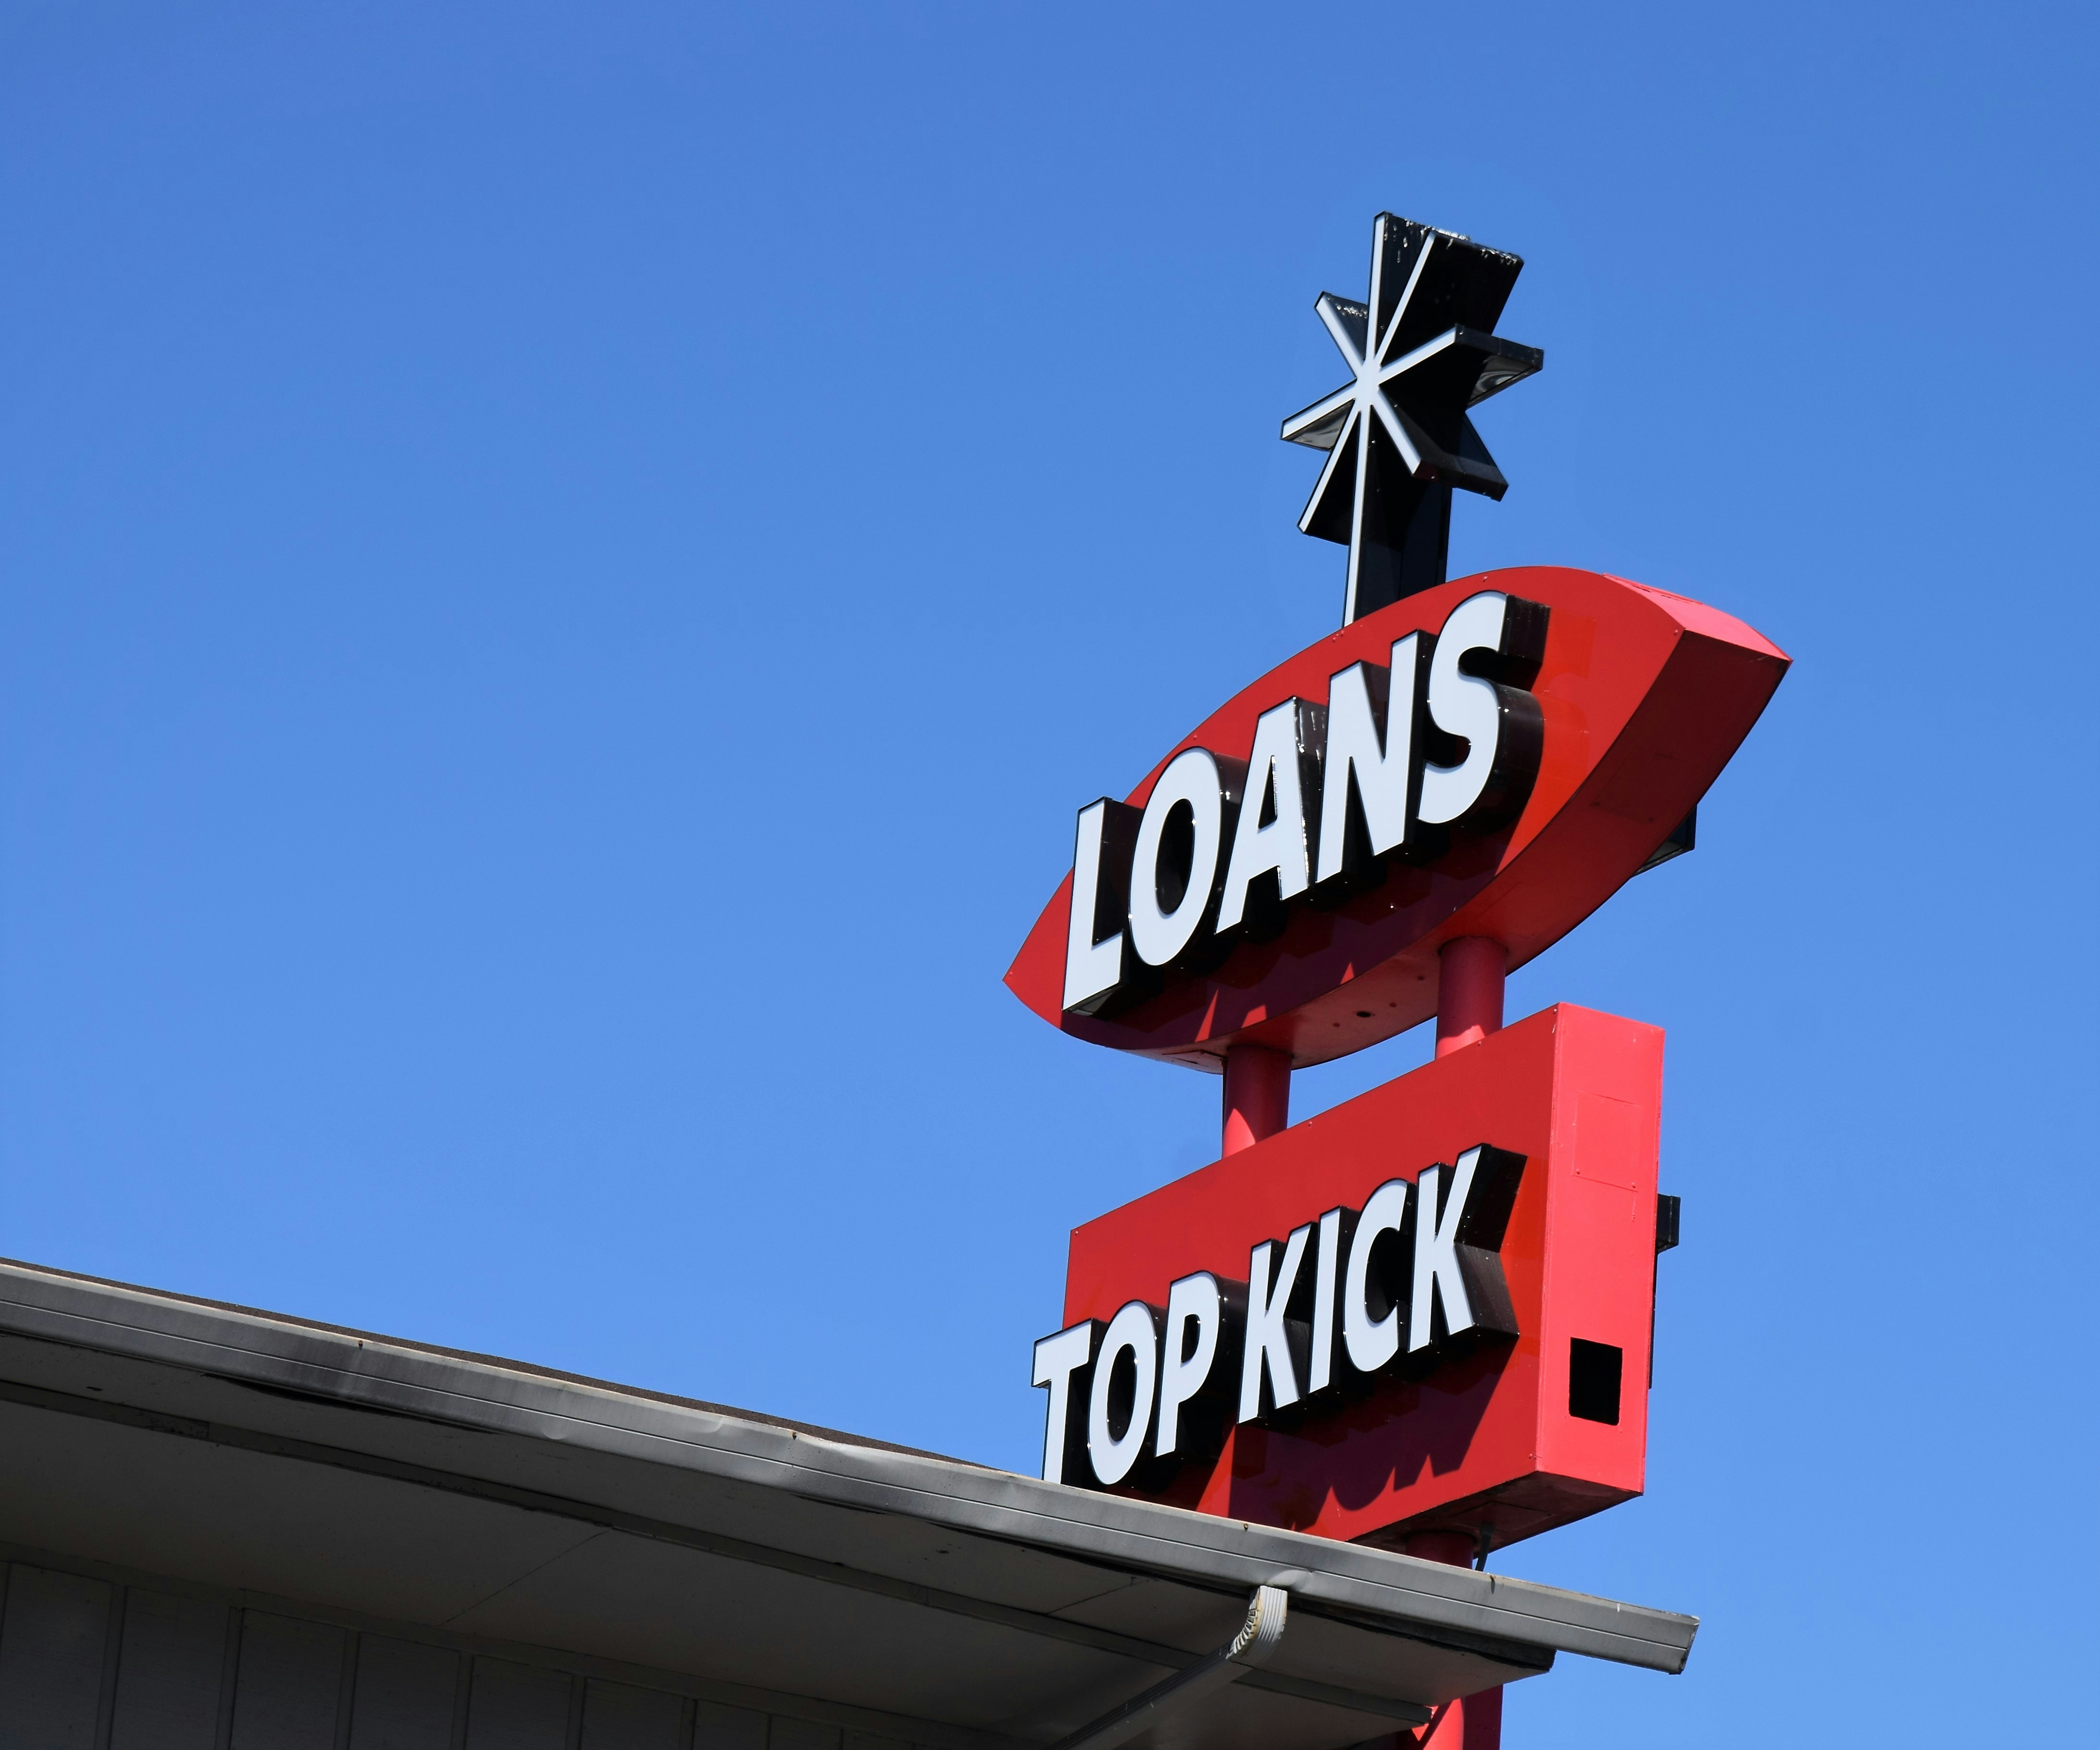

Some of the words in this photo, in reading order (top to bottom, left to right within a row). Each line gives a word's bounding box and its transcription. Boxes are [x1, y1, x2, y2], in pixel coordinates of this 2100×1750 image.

[1062, 591, 1507, 1011] LOANS
[1032, 1270, 1221, 1485] TOP
[1237, 1143, 1484, 1424] KICK
